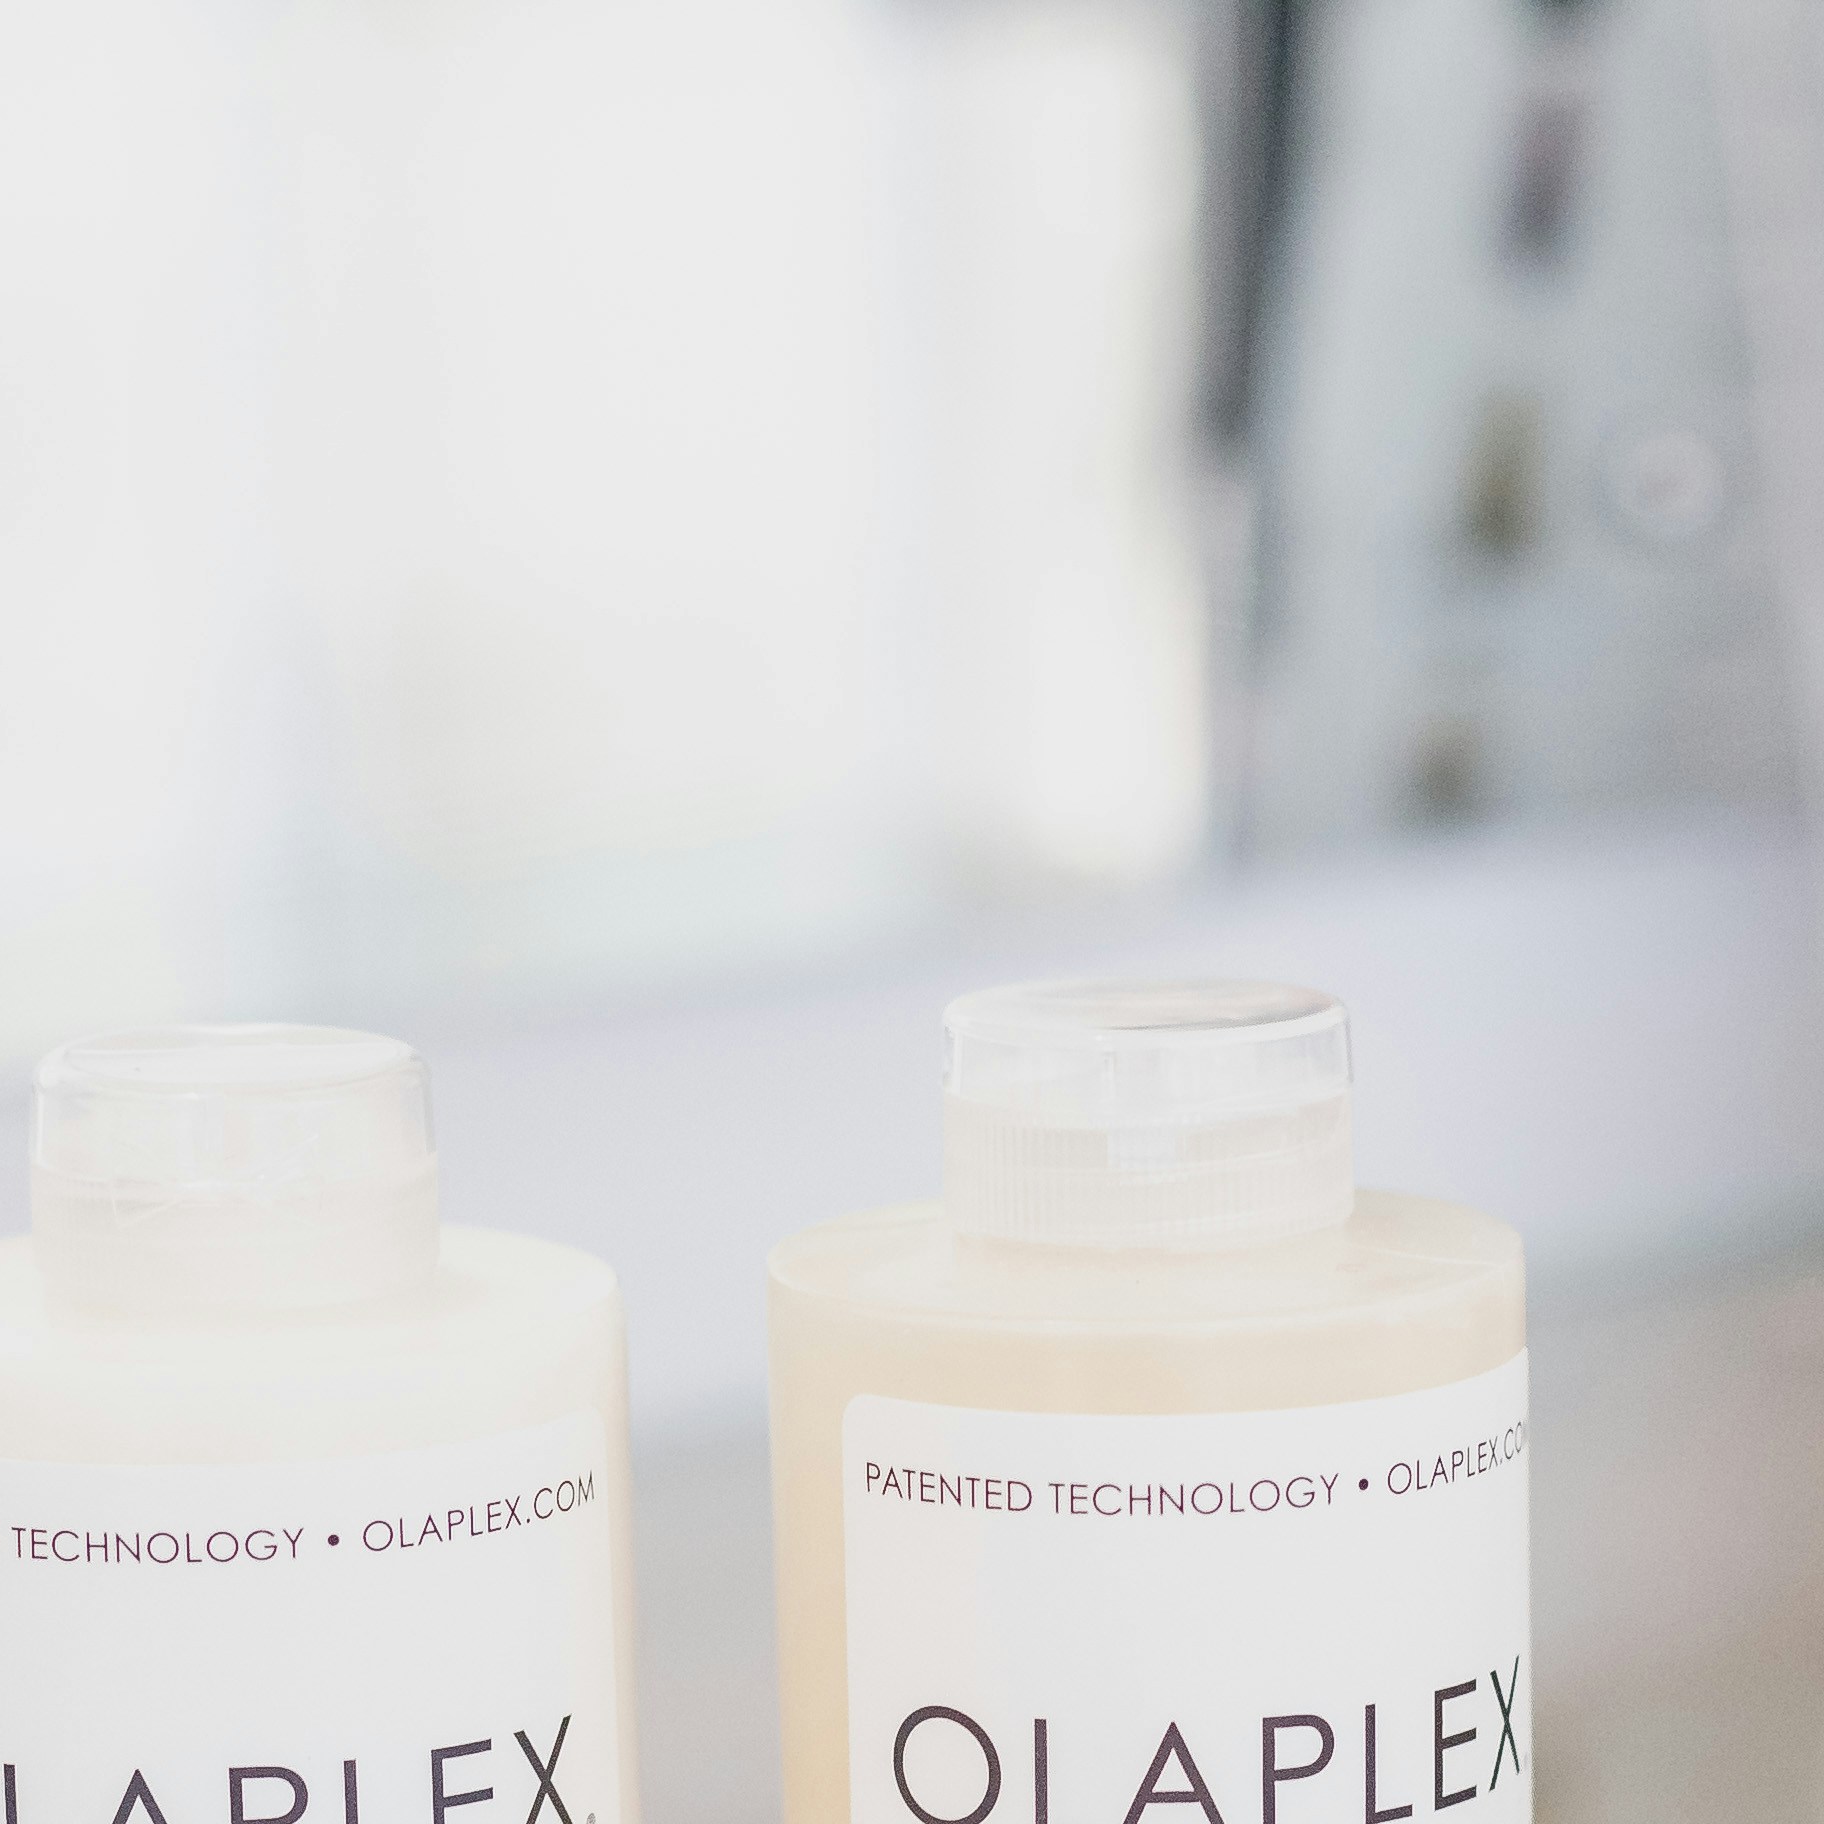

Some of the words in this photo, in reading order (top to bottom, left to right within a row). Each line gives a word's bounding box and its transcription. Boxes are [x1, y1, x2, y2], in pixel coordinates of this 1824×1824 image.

[866, 1461, 1033, 1512] PATENTED
[1048, 1473, 1339, 1516] TECHNOLOGY
[1387, 1421, 1527, 1495] OLAPLEX.CO
[11, 1526, 304, 1564] TECHNOLOGY
[362, 1471, 594, 1552] OLAPLEX.COM
